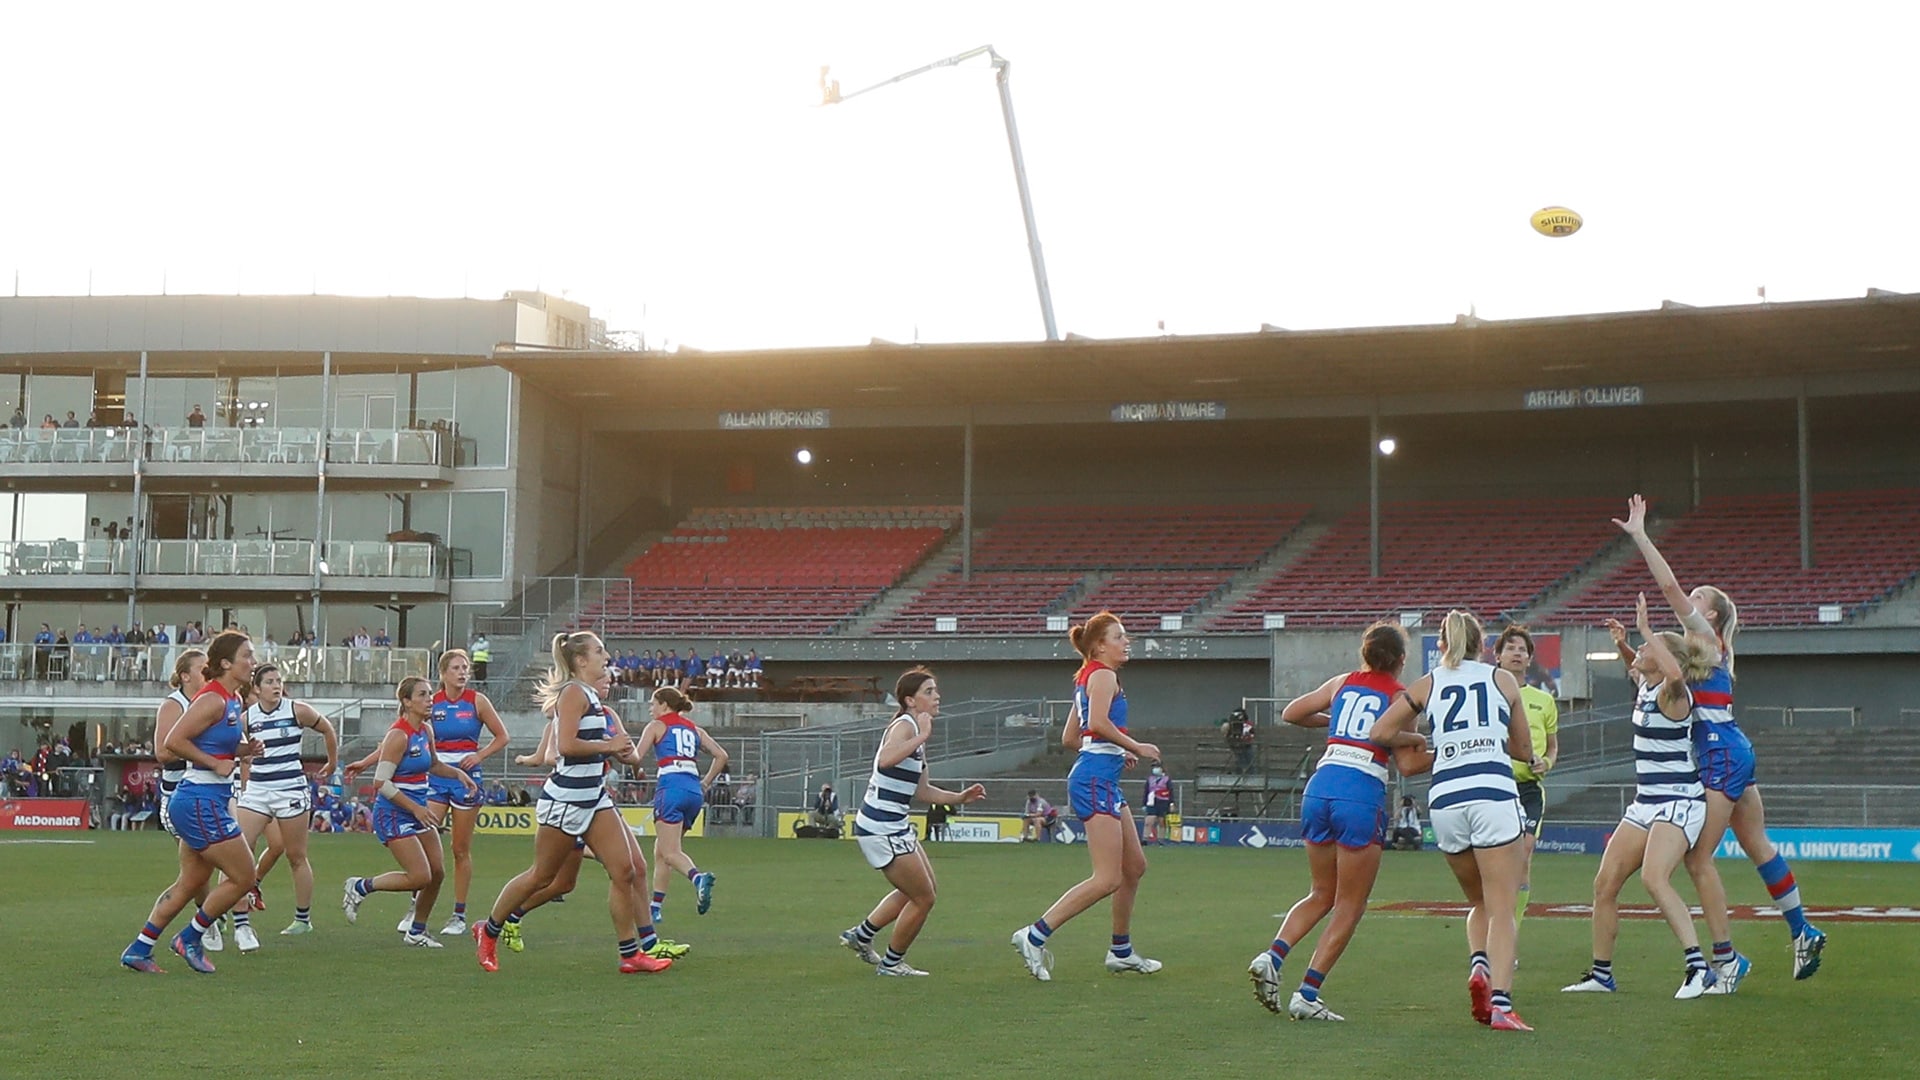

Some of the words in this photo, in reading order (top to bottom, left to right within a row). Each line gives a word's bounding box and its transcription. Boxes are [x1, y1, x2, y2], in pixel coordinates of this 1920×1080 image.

[1527, 389, 1581, 407] ARTHUR
[1584, 386, 1641, 404] OLLIVER
[725, 411, 766, 427] ALLAN
[769, 410, 824, 427] HOPKINS
[1120, 403, 1176, 420] NORMAN
[1179, 402, 1216, 418] WARE
[1335, 690, 1382, 740] 16
[1440, 682, 1490, 734] 21
[671, 727, 697, 758] 19
[1460, 738, 1496, 750] DEAKIN
[14, 815, 82, 827] McDonald's
[477, 812, 532, 830] OADS
[1535, 839, 1587, 853] Maribyrnong
[1800, 842, 1893, 859] UNIVERSITY
